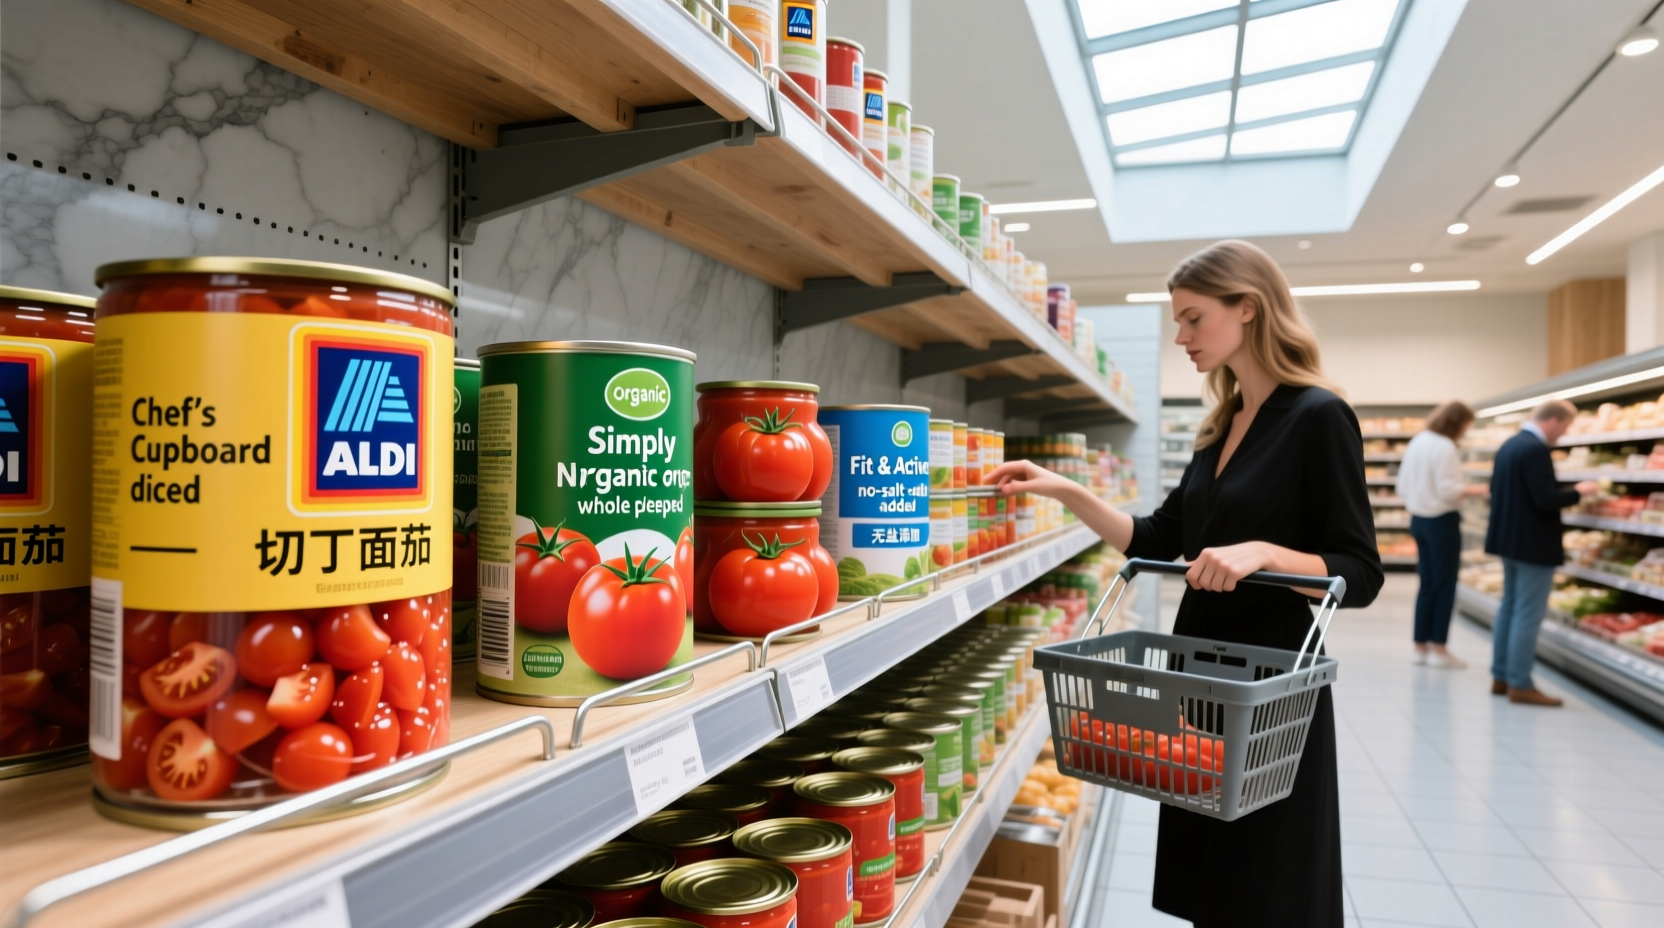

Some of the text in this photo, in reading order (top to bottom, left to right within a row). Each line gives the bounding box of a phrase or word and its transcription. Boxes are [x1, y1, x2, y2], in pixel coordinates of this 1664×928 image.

[132, 396, 216, 427] Chef's
[613, 385, 666, 407] Organic
[131, 434, 271, 471] Cupboard
[322, 441, 415, 476] ALDI
[587, 425, 676, 463] Simply
[850, 455, 873, 475] Fit
[877, 455, 891, 475] &
[131, 473, 200, 503] diced
[577, 495, 630, 514] whole
[255, 522, 431, 577] 切丁面茄
